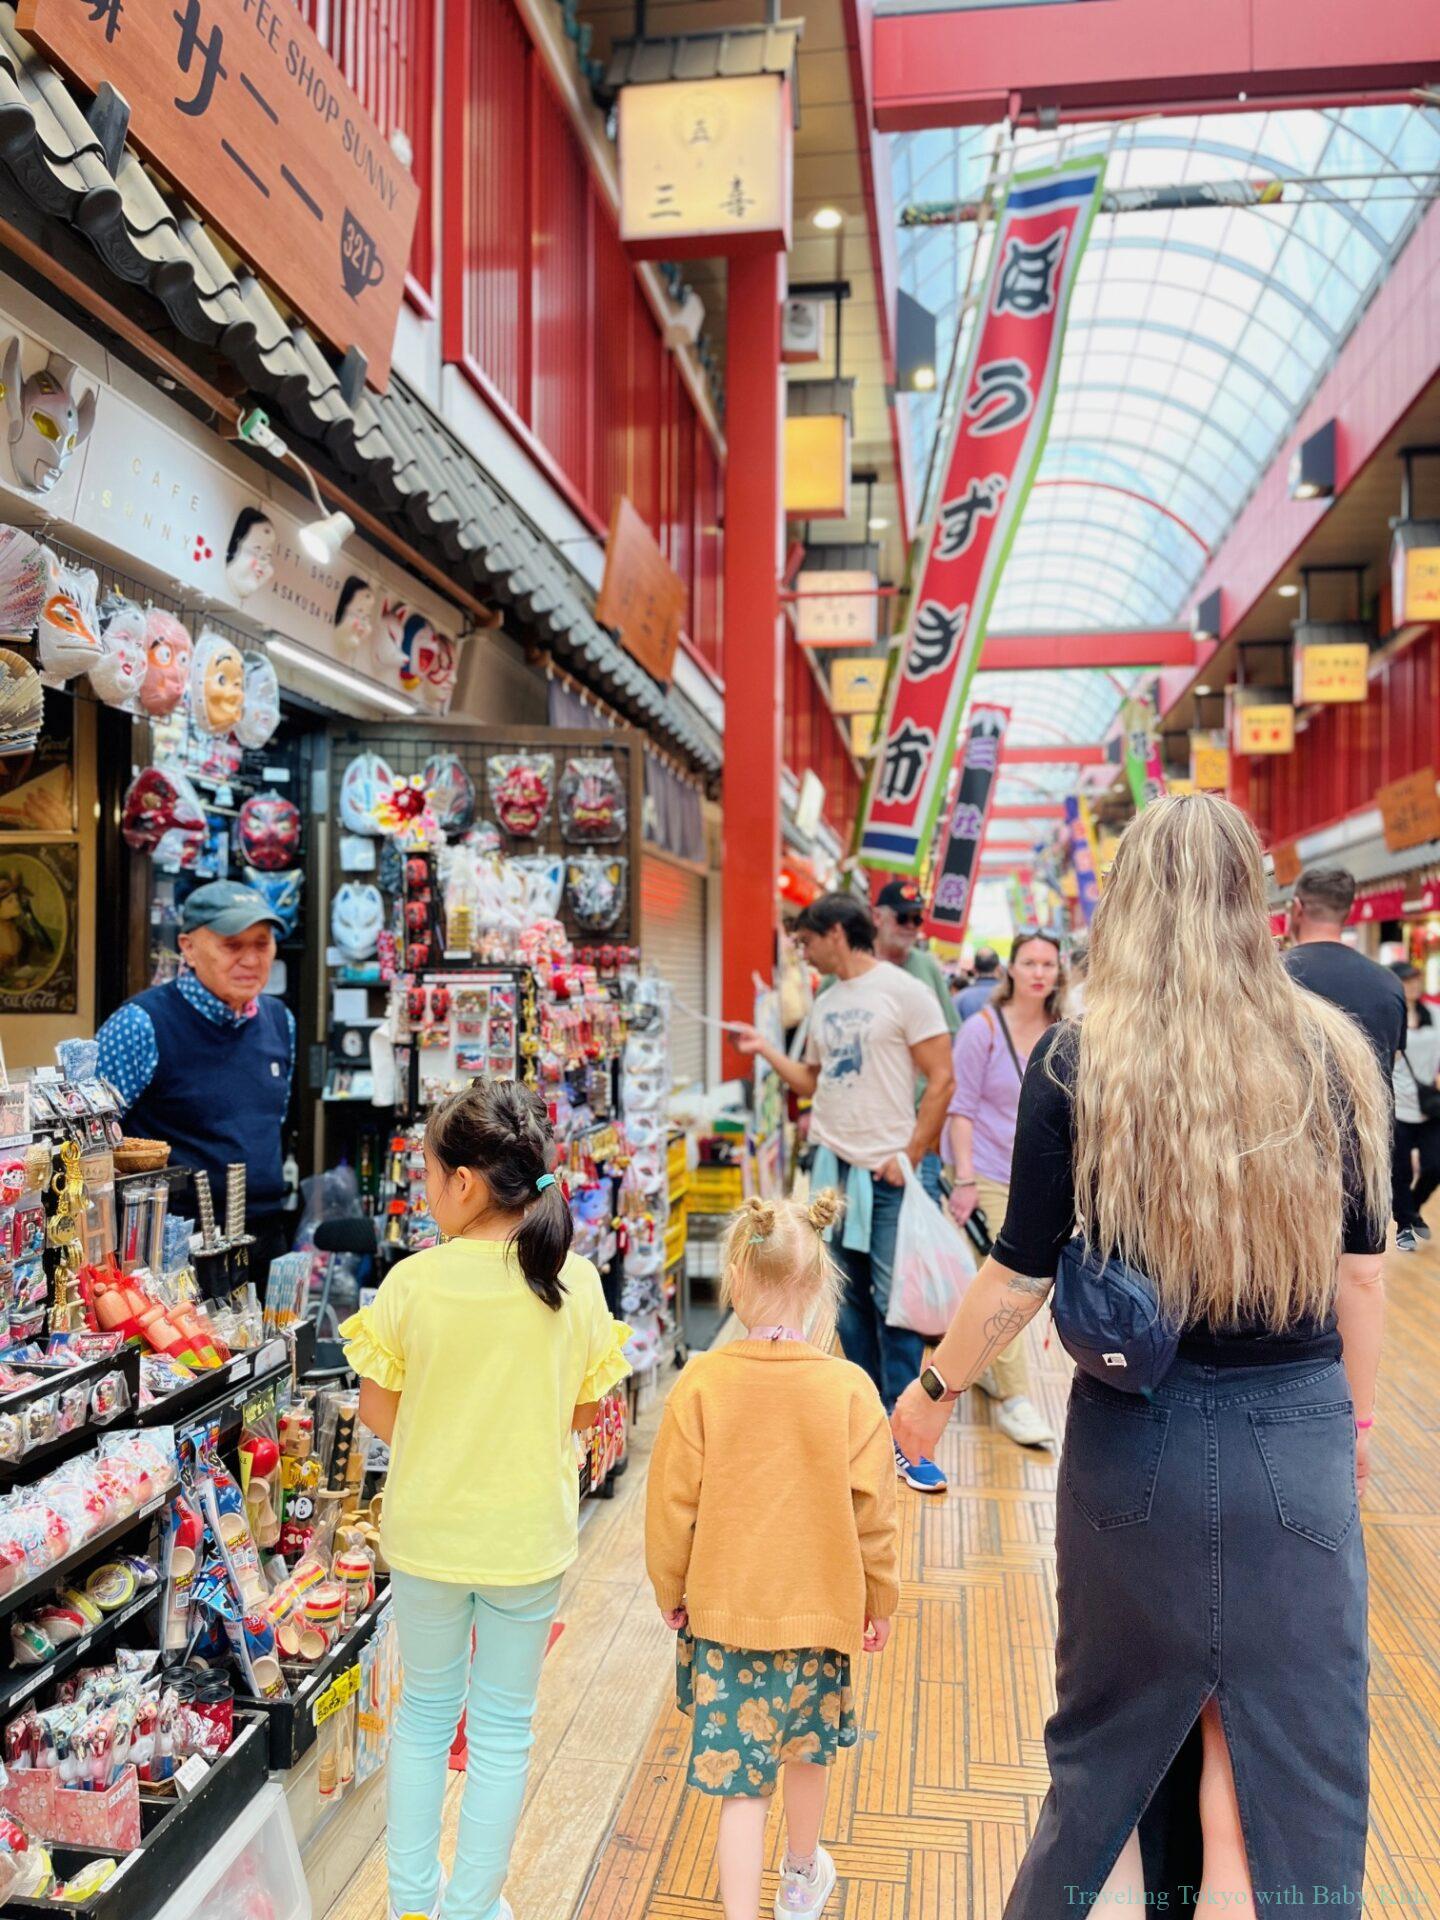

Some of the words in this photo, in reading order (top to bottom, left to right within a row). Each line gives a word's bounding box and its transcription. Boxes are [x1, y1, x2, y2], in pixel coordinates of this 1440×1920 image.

[285, 39, 340, 124] SHOP
[342, 118, 398, 211] SUNNY
[342, 222, 370, 277] 321
[131, 457, 200, 513] CAFE
[101, 488, 193, 549] SUNNY
[310, 565, 342, 590] SHOP
